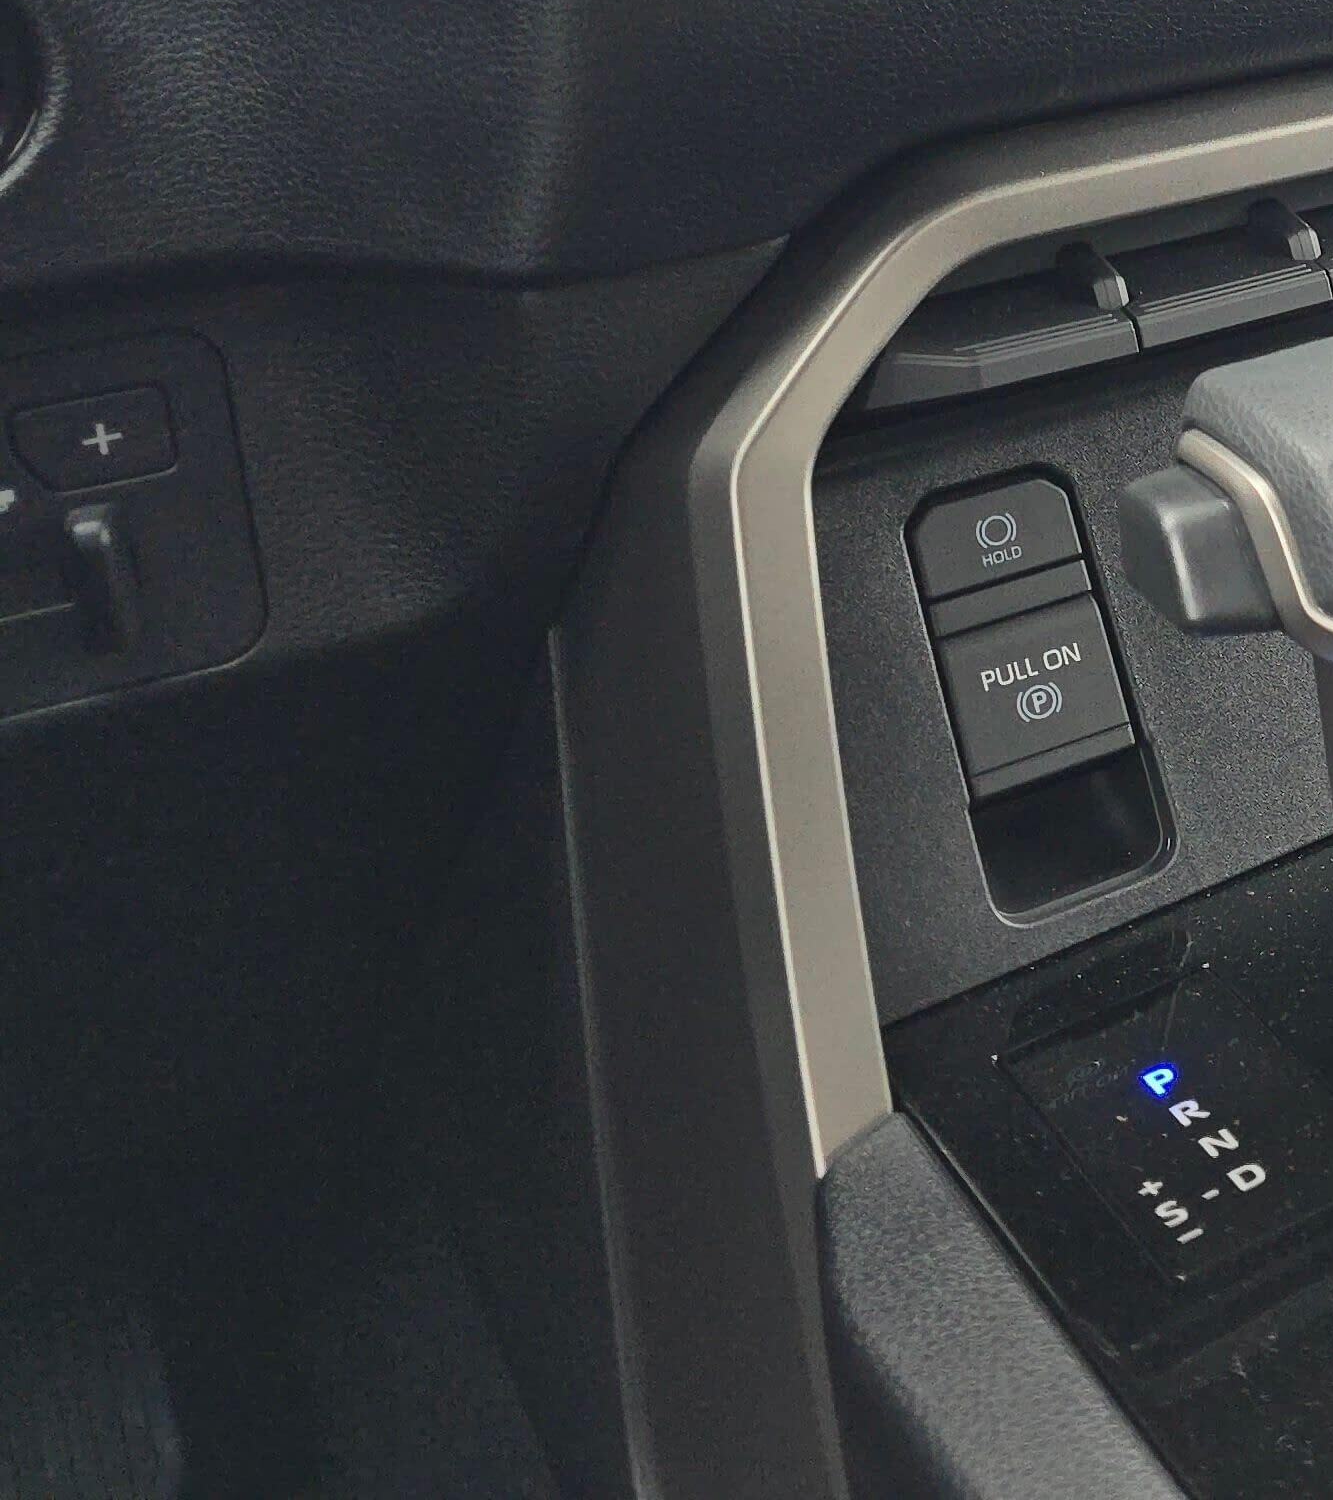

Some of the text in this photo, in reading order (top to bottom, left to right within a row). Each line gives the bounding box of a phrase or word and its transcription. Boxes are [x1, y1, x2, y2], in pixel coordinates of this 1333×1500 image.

[982, 545, 1023, 568] HOLD
[980, 642, 1082, 692] PULL ON
[1142, 1067, 1175, 1095] P
[1168, 1100, 1211, 1127] R
[1198, 1128, 1239, 1158] N
[1226, 1163, 1266, 1192] D
[1154, 1200, 1189, 1228] S
